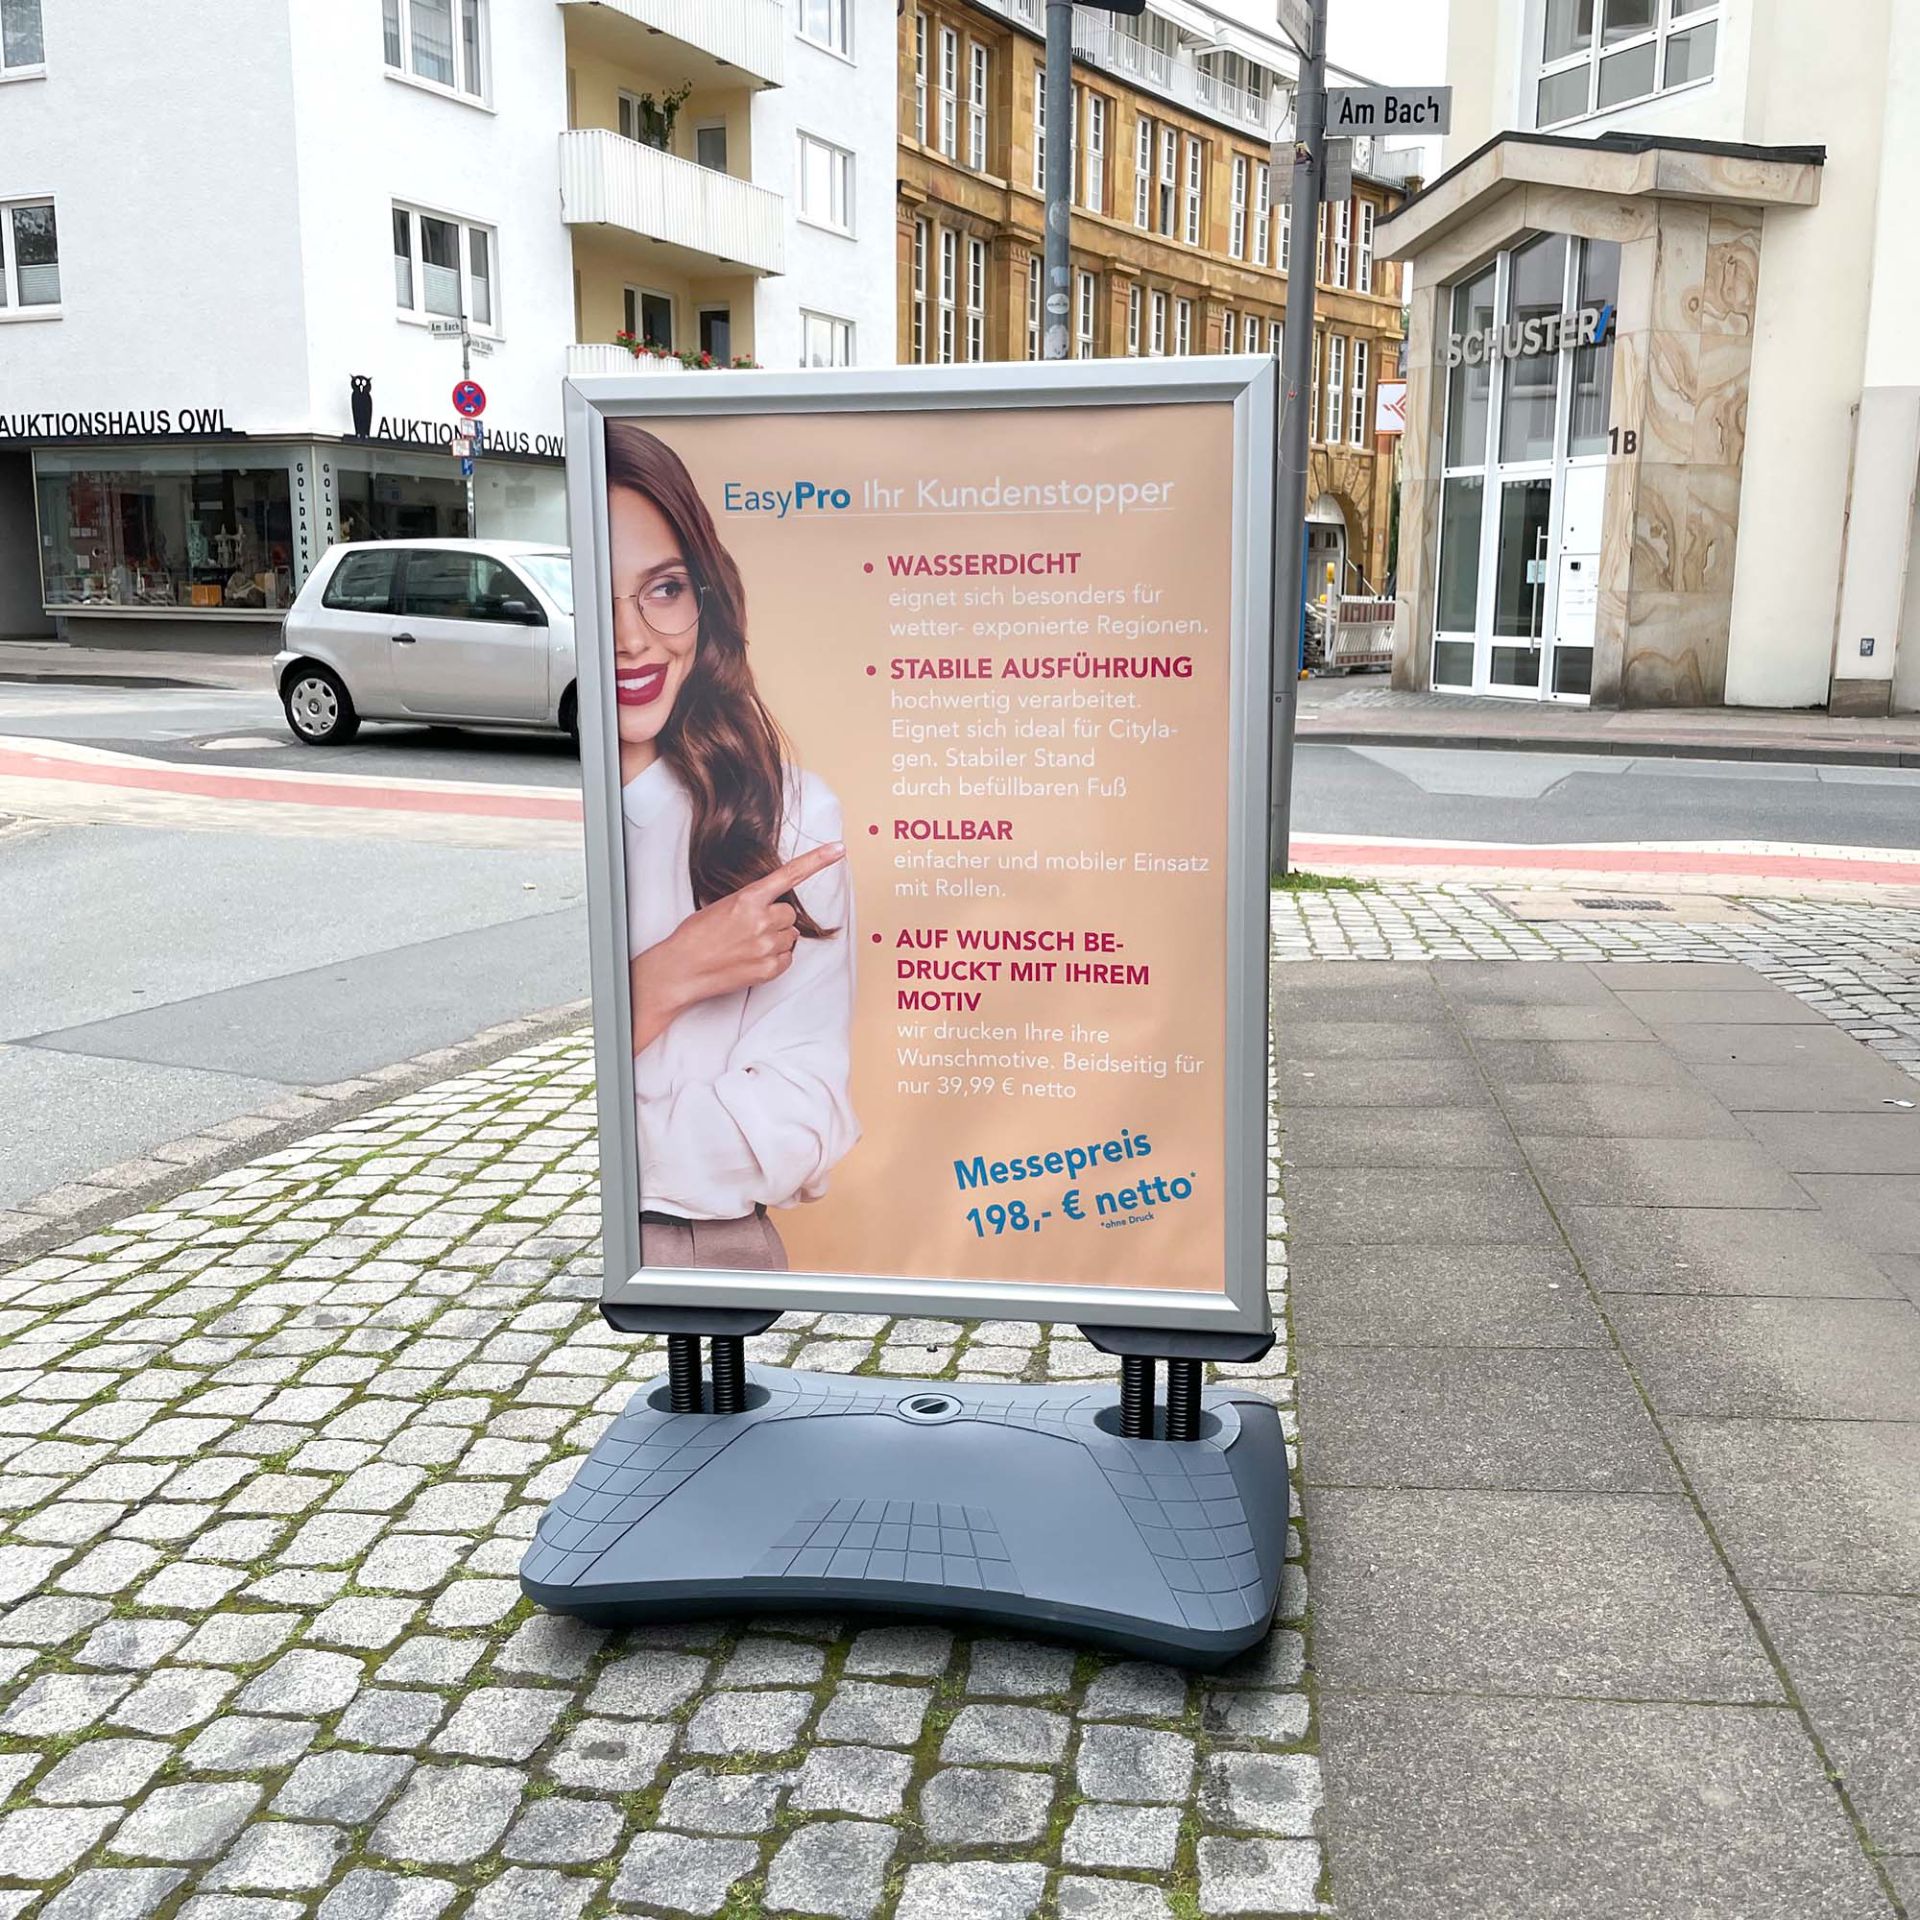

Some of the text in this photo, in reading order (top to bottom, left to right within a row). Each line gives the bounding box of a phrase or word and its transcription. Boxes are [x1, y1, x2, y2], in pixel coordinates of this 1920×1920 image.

[1339, 96, 1439, 124] Am Bach
[431, 322, 441, 332] Am
[0, 409, 232, 437] AUKTIONSHAUS OWL
[377, 416, 529, 451] AUKTIONHAUS
[535, 434, 564, 456] OW
[1608, 427, 1636, 455] 1B
[725, 476, 1174, 518] EasyPro Ihr Kundenstopper
[296, 462, 309, 584] GOLDANKA
[888, 553, 1081, 576] WASSERDICHT
[889, 584, 1163, 612] eignet sich besonders für
[890, 616, 1209, 640] wetter- exponierte Regionen.
[891, 652, 1192, 679] STABILE AUSFÜHRUNG
[891, 689, 1142, 713] hochwertig verarbeitet.
[892, 719, 1178, 744] Eignet sich ideal für Cityla-
[892, 748, 1095, 772] gen. Stabiler Stand
[892, 777, 1126, 797] durch befüllbaren Fuß
[894, 819, 1013, 840] ROLLBAR
[894, 852, 1209, 872] einfacher und mobiler Einsatz
[895, 879, 1006, 898] mit Rollen.
[896, 929, 1124, 952] AUF WUNSCH BE-
[897, 961, 1149, 985] DRUCKT MIT IHREM
[897, 991, 981, 1011] MOTIV
[897, 1022, 1109, 1043] wir drucken Ihre ihre
[897, 1049, 1203, 1077] Wunschmotive. Beidseitig für
[897, 1077, 1075, 1099] nur 39,99 € netto
[953, 1129, 1152, 1190] Messepreis
[966, 1200, 1052, 1237] 198,-
[1062, 1189, 1086, 1220] €
[1128, 1212, 1154, 1224] Druck
